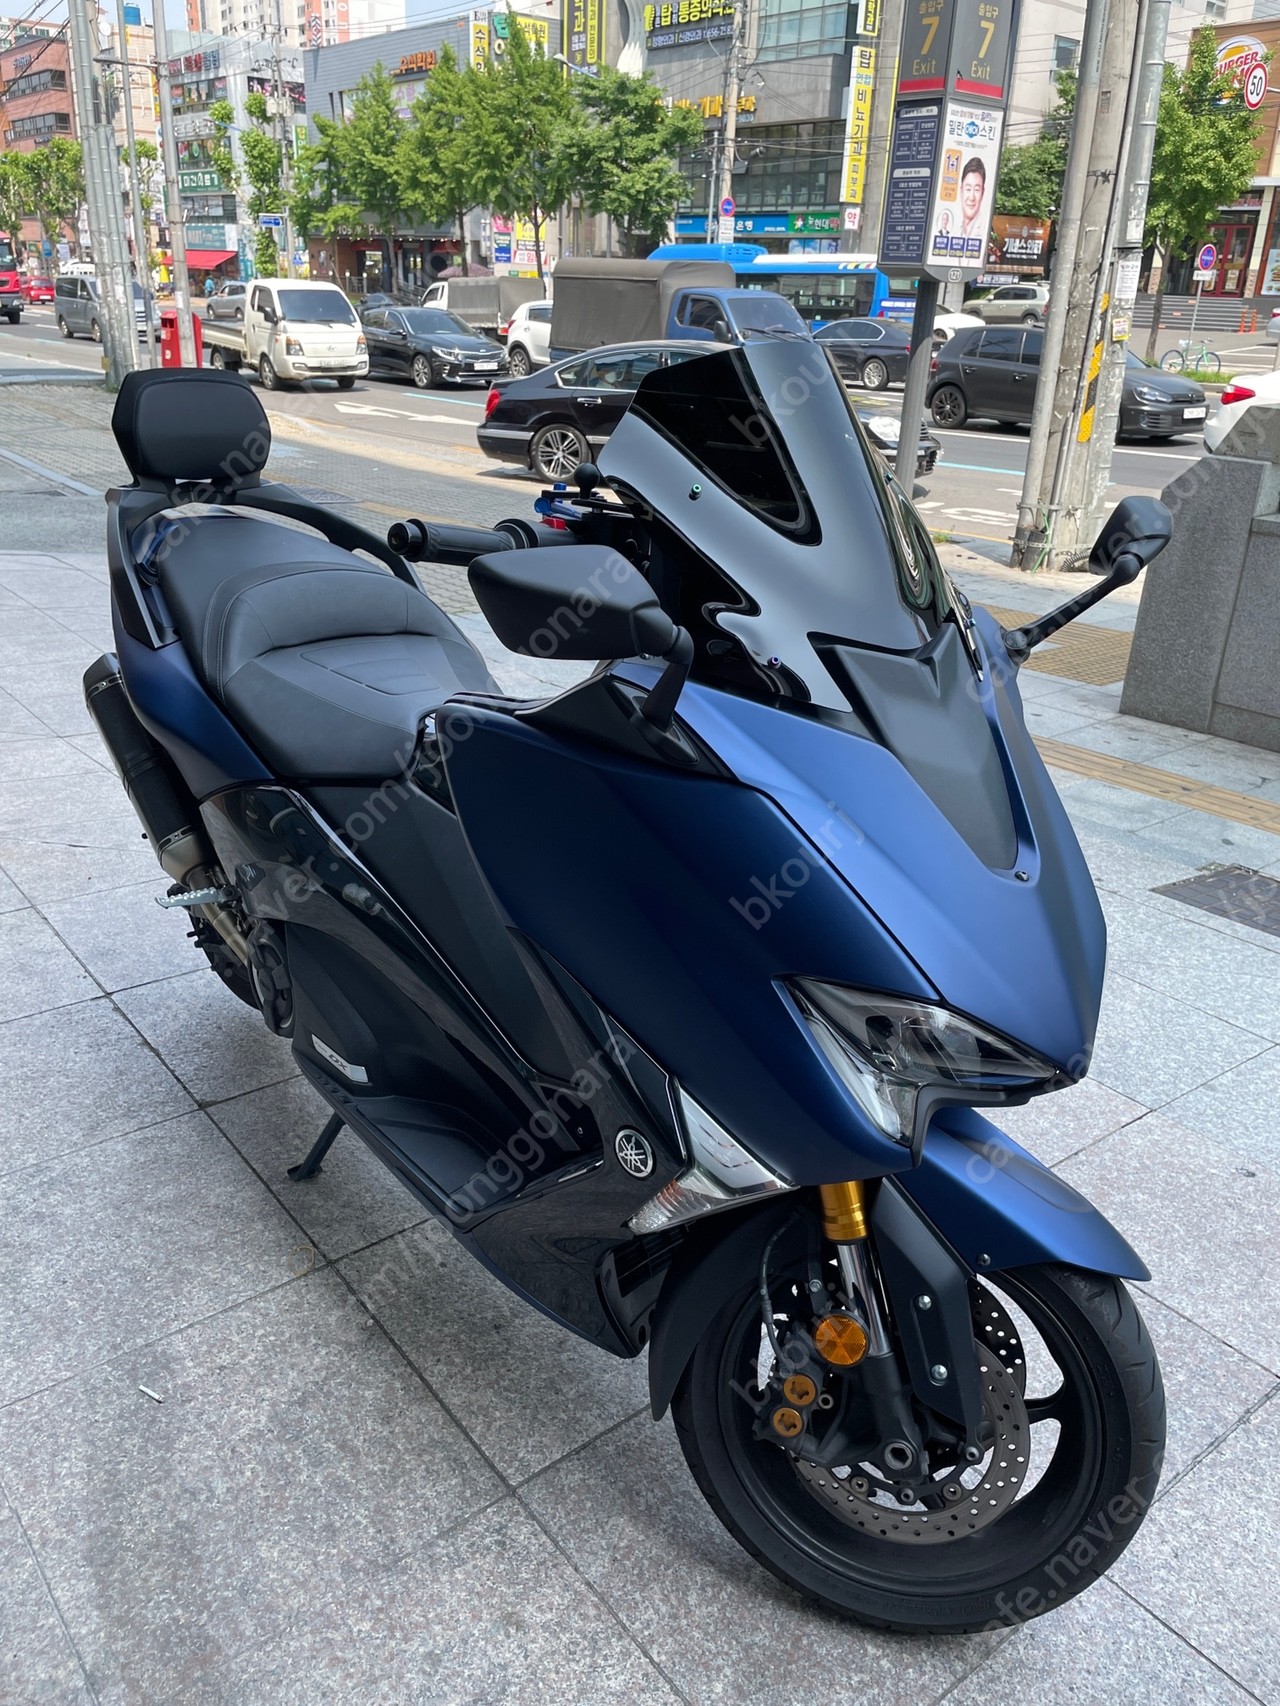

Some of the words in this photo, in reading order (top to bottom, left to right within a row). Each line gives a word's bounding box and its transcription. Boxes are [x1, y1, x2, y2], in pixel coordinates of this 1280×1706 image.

[918, 0, 944, 15] 출입구
[979, 3, 999, 19] 출입구
[921, 16, 940, 55] 7
[978, 20, 995, 59] 7
[912, 58, 936, 75] Exit
[970, 61, 990, 80] Exit
[1249, 74, 1263, 97] 50
[852, 89, 867, 156] 비뇨기과
[847, 212, 857, 227] 약
[368, 223, 395, 236] PLAE
